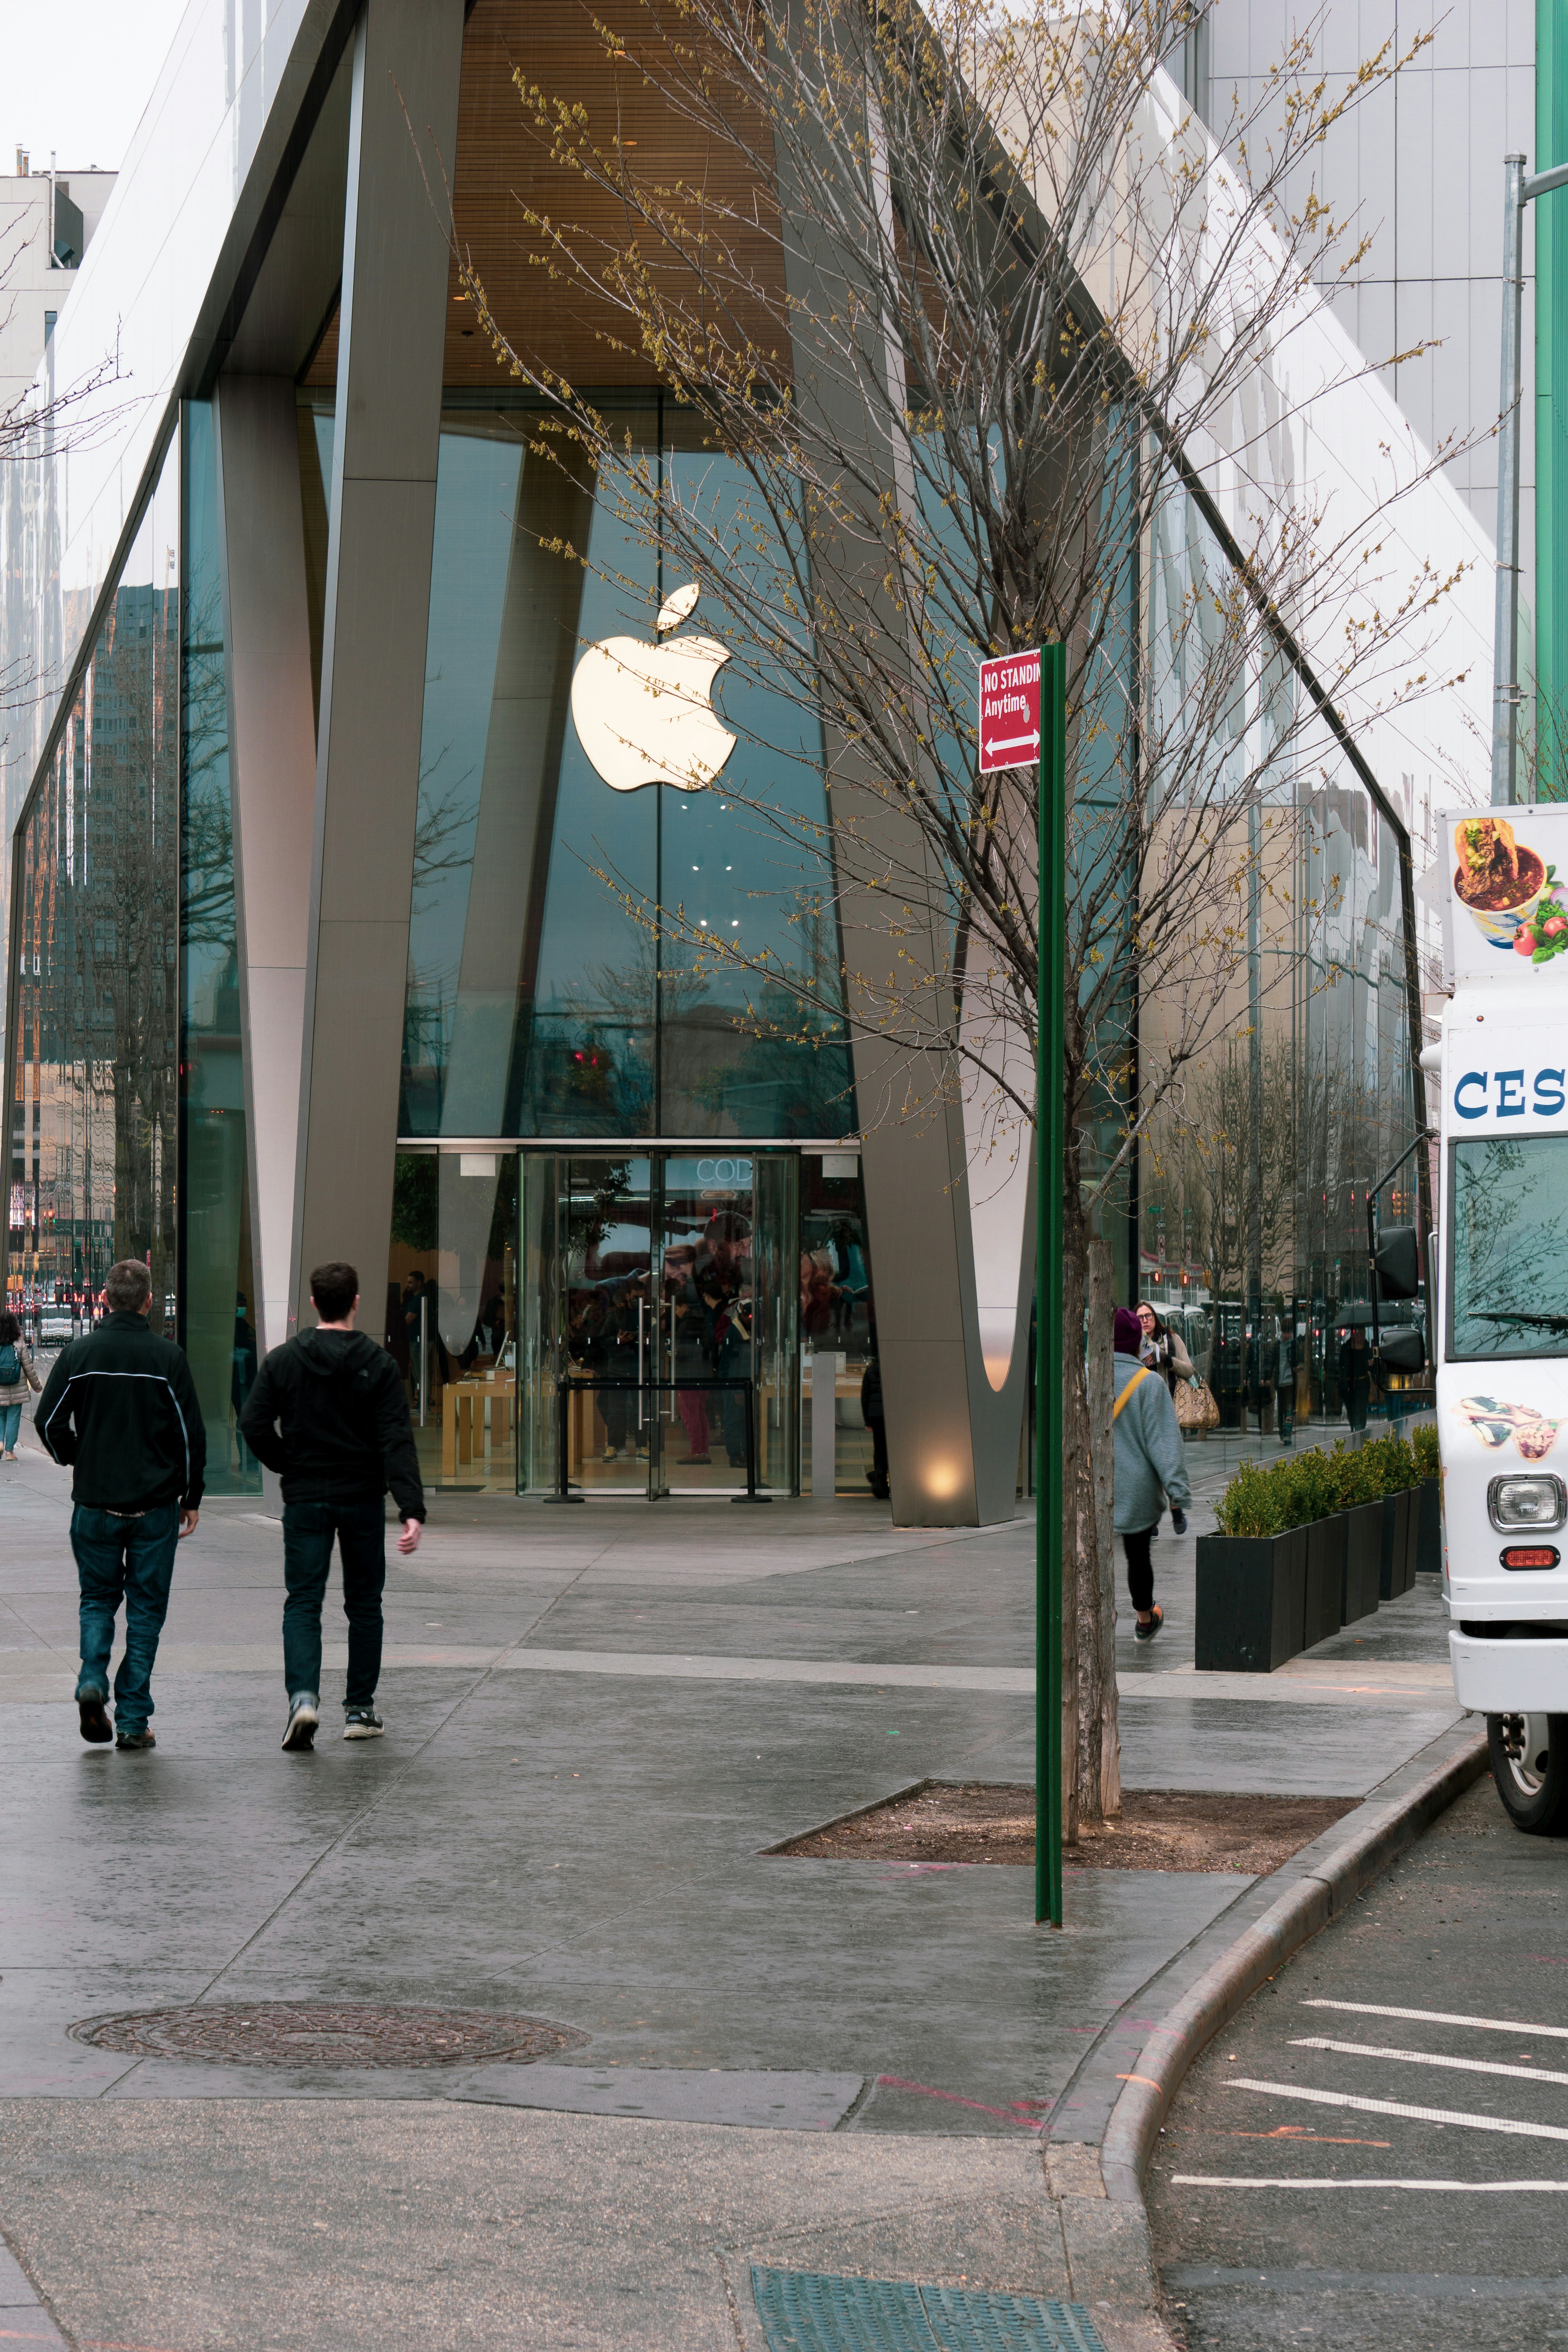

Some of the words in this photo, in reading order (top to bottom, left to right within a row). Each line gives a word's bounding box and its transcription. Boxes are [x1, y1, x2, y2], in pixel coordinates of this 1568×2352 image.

[985, 672, 998, 693] NO
[985, 693, 1026, 719] Anytime
[1454, 1069, 1566, 1119] CES
